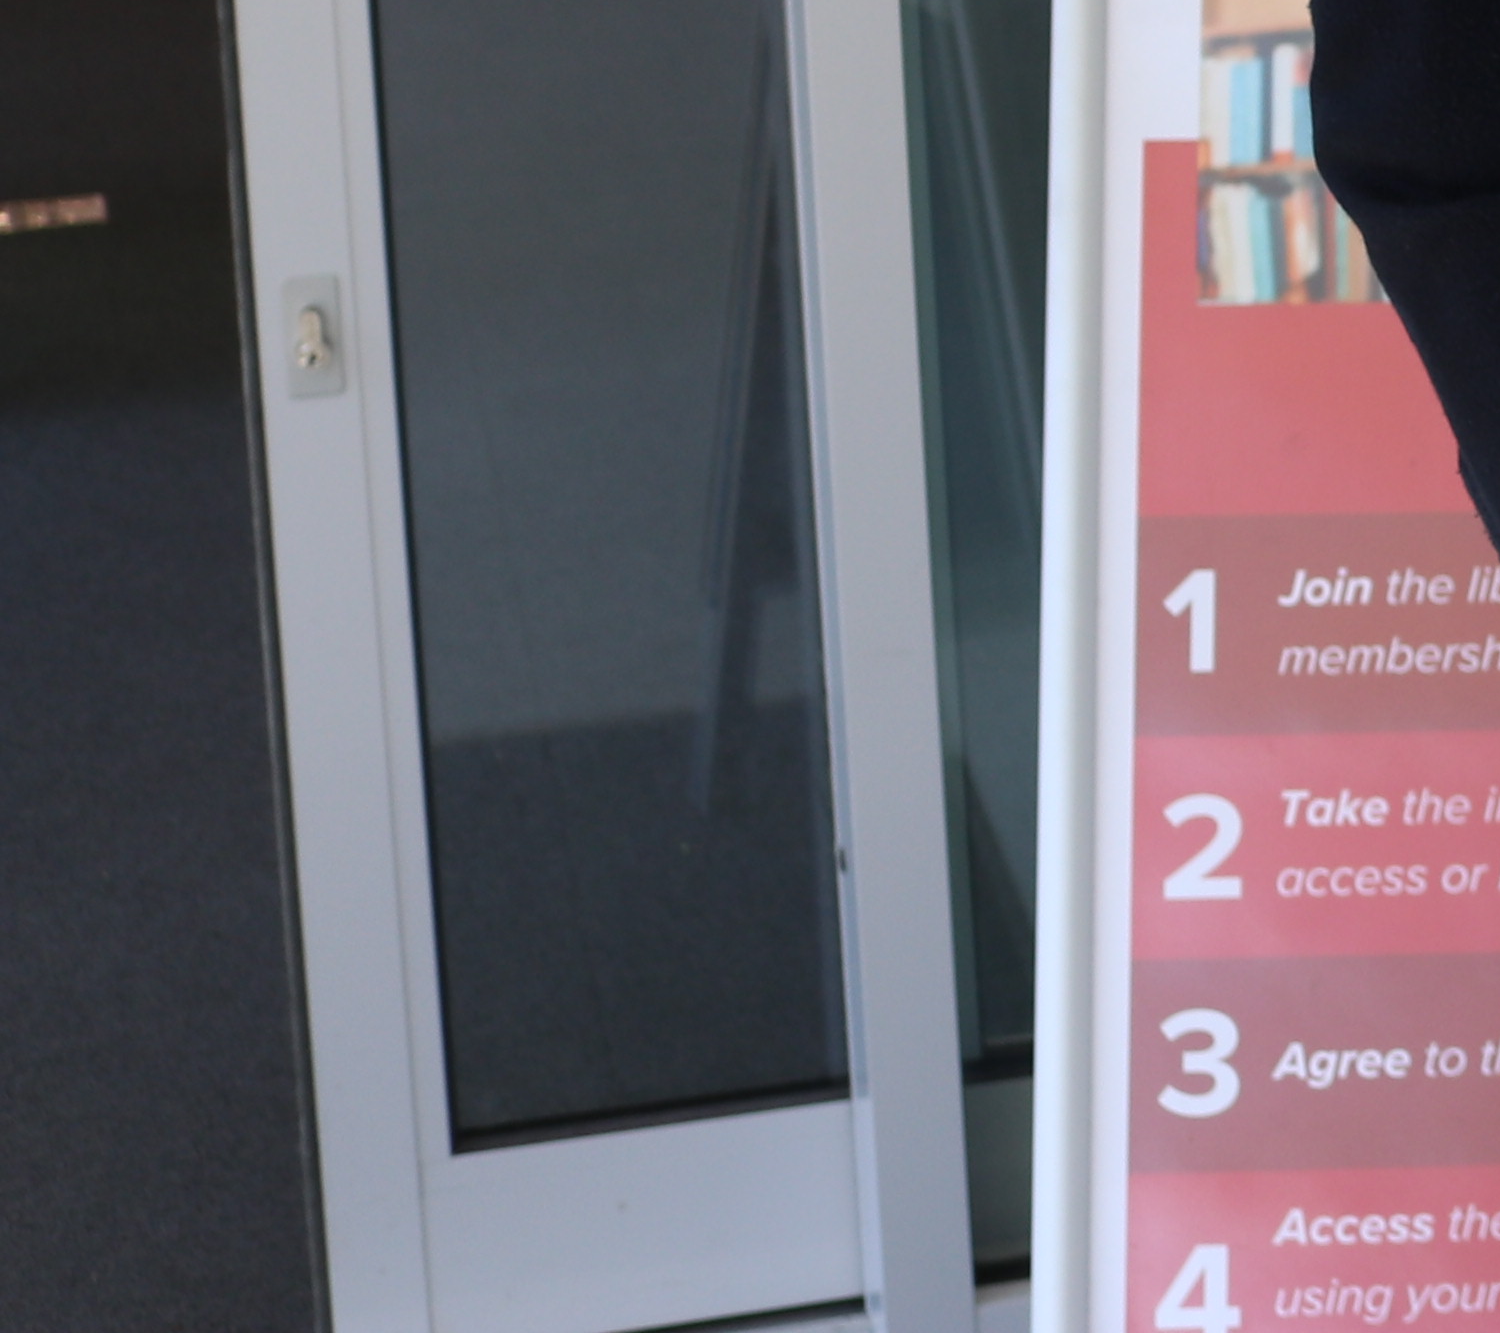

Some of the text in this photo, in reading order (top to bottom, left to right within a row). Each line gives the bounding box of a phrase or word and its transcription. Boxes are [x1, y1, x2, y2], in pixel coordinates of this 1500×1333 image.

[1277, 569, 1374, 607] Join
[1386, 568, 1455, 605] the
[1163, 568, 1216, 674] 1
[1280, 789, 1389, 827] Take
[1402, 787, 1471, 824] the
[1163, 792, 1244, 901] 2
[1277, 864, 1427, 897] access
[1441, 863, 1488, 894] or
[1157, 1007, 1241, 1118] 3
[1271, 1041, 1411, 1089] Agree
[1424, 1040, 1467, 1077] to
[1273, 1207, 1434, 1246] Access
[1154, 1243, 1242, 1333] 4
[1274, 1278, 1394, 1324] using
